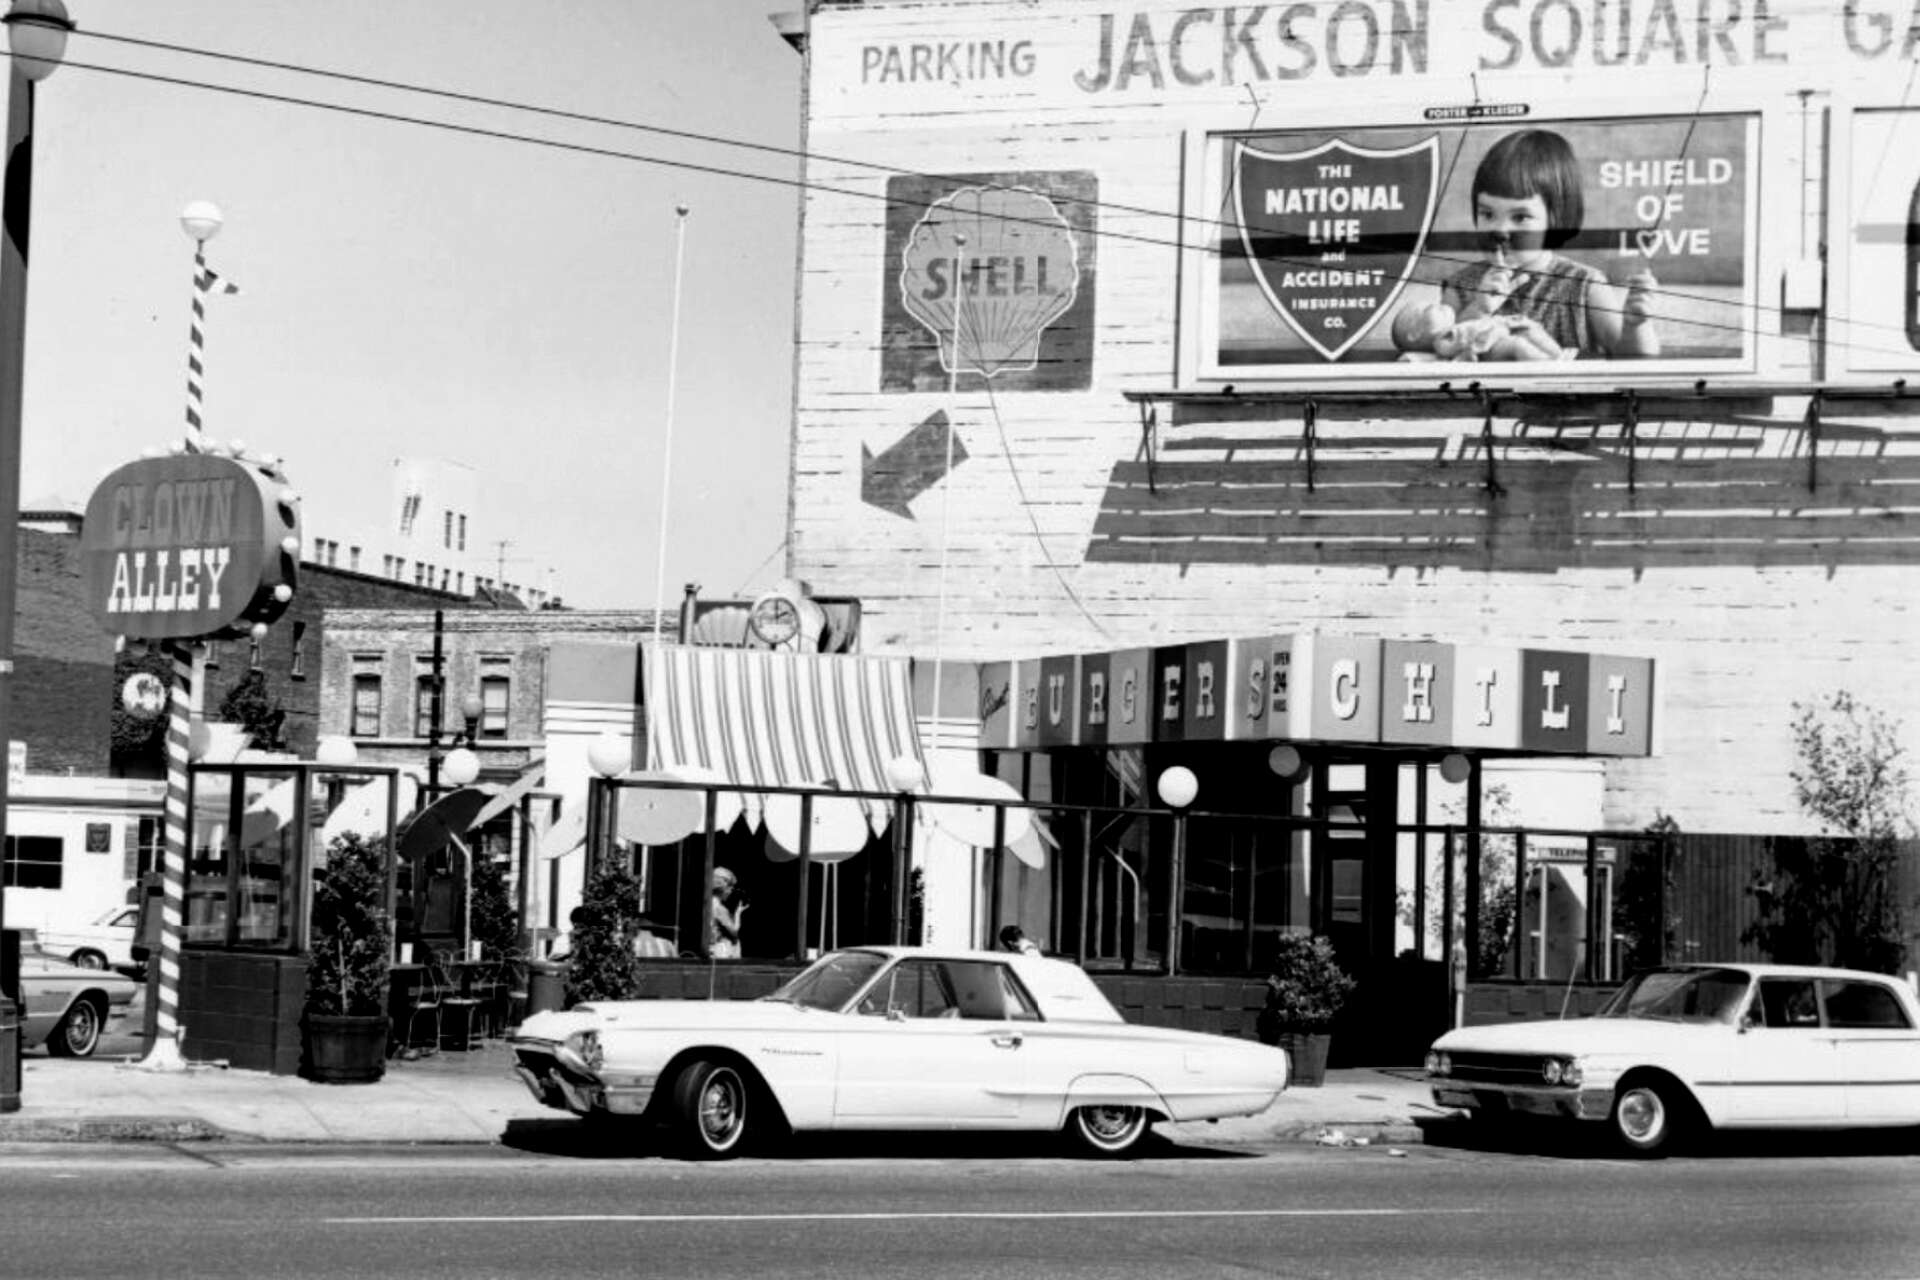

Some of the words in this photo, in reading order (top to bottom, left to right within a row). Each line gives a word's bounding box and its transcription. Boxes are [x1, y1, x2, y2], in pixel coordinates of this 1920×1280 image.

[861, 39, 1037, 84] PARKING
[1073, 0, 1430, 93] JACKSON
[1479, 0, 1790, 70] SQUARE
[1318, 164, 1352, 178] THE
[1599, 157, 1733, 188] SHIELD
[1264, 184, 1405, 215] NATIONAL
[1637, 193, 1684, 221] OF
[1308, 218, 1361, 244] LIFE
[1619, 228, 1710, 258] LOVE
[1320, 250, 1346, 262] and
[922, 256, 1058, 300] SHELL
[1281, 269, 1386, 288] ACCIDENT
[1291, 296, 1377, 310] INSURANCE
[1323, 316, 1346, 328] CO.
[112, 478, 236, 549] CLOWN
[107, 546, 230, 613] ALLEY
[1023, 656, 1267, 731] BURGERS
[1330, 658, 1627, 735] CHILI
